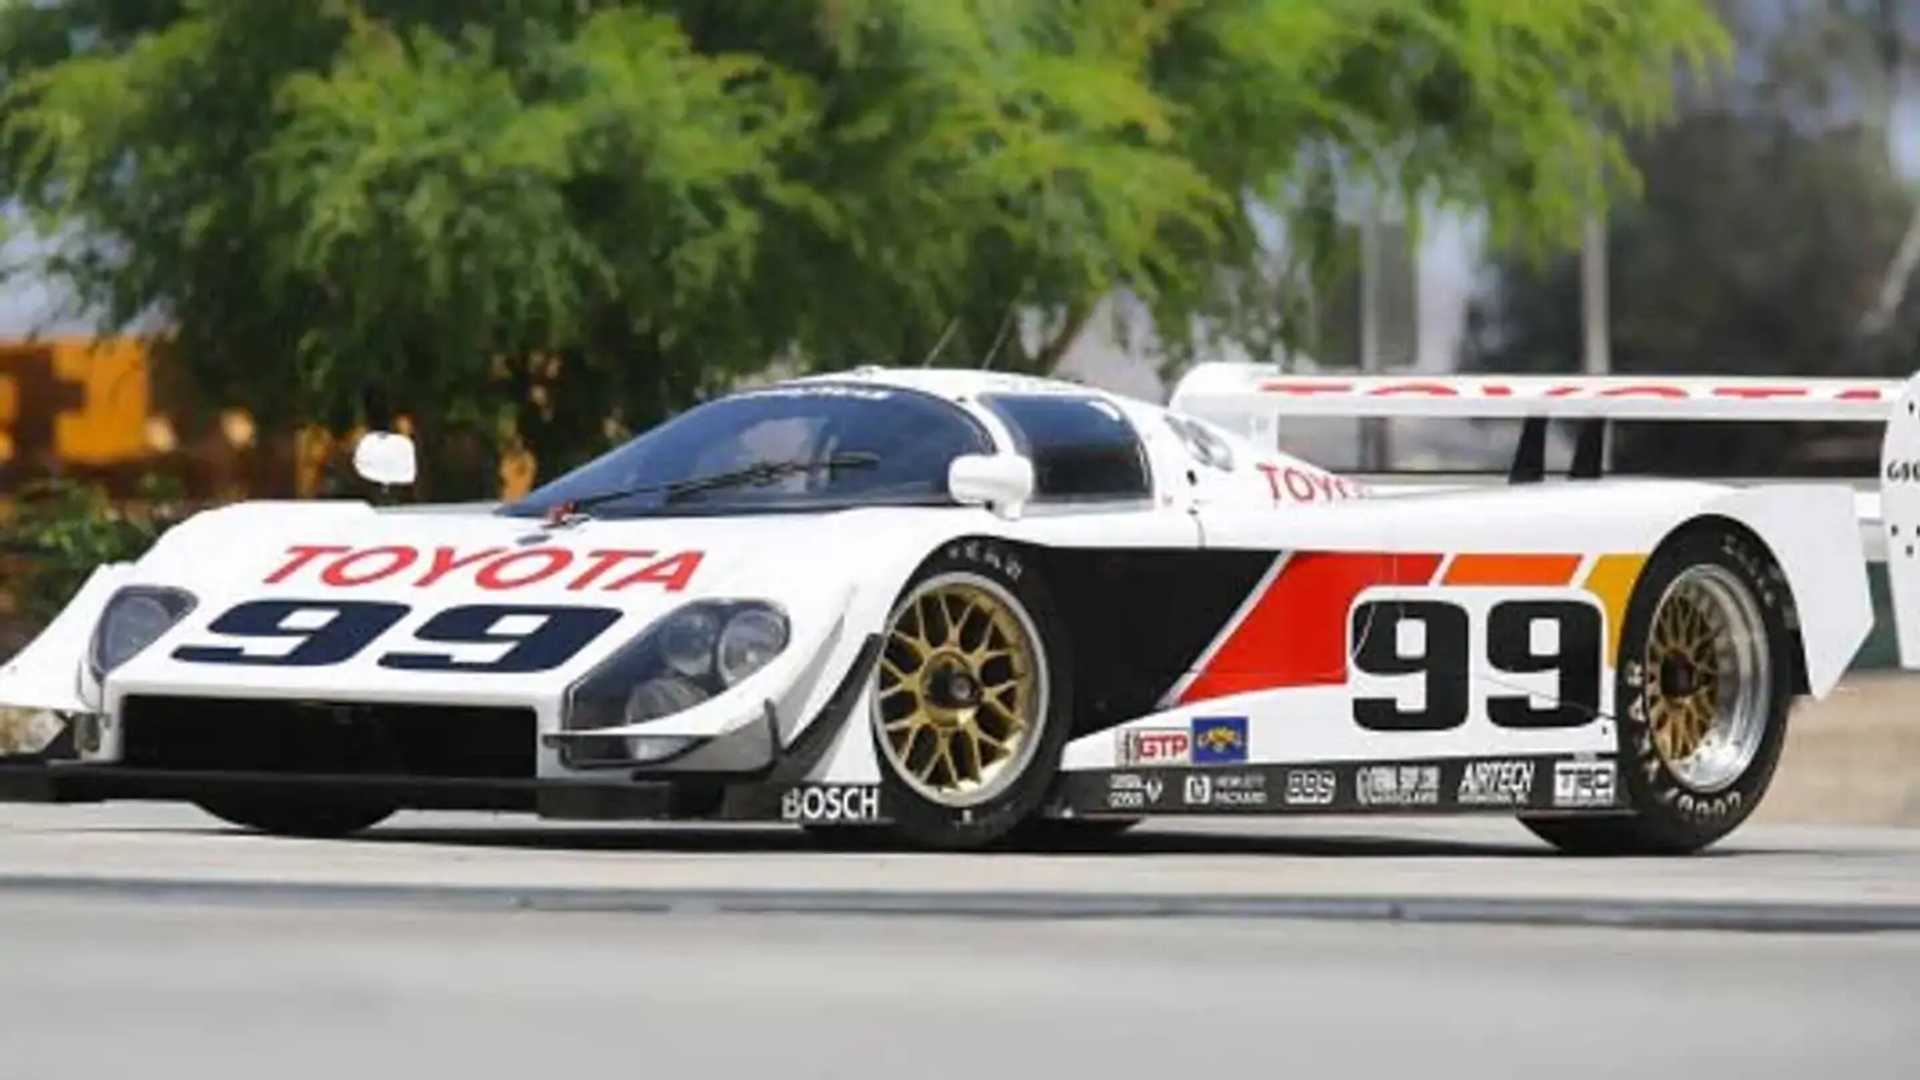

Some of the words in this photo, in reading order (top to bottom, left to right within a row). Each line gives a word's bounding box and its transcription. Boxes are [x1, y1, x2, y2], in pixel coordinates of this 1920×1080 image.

[263, 545, 706, 592] TOYOTA
[170, 599, 624, 673] 99
[1352, 600, 1601, 731] 99
[1140, 734, 1189, 758] GTP
[782, 786, 879, 819] BOSCH
